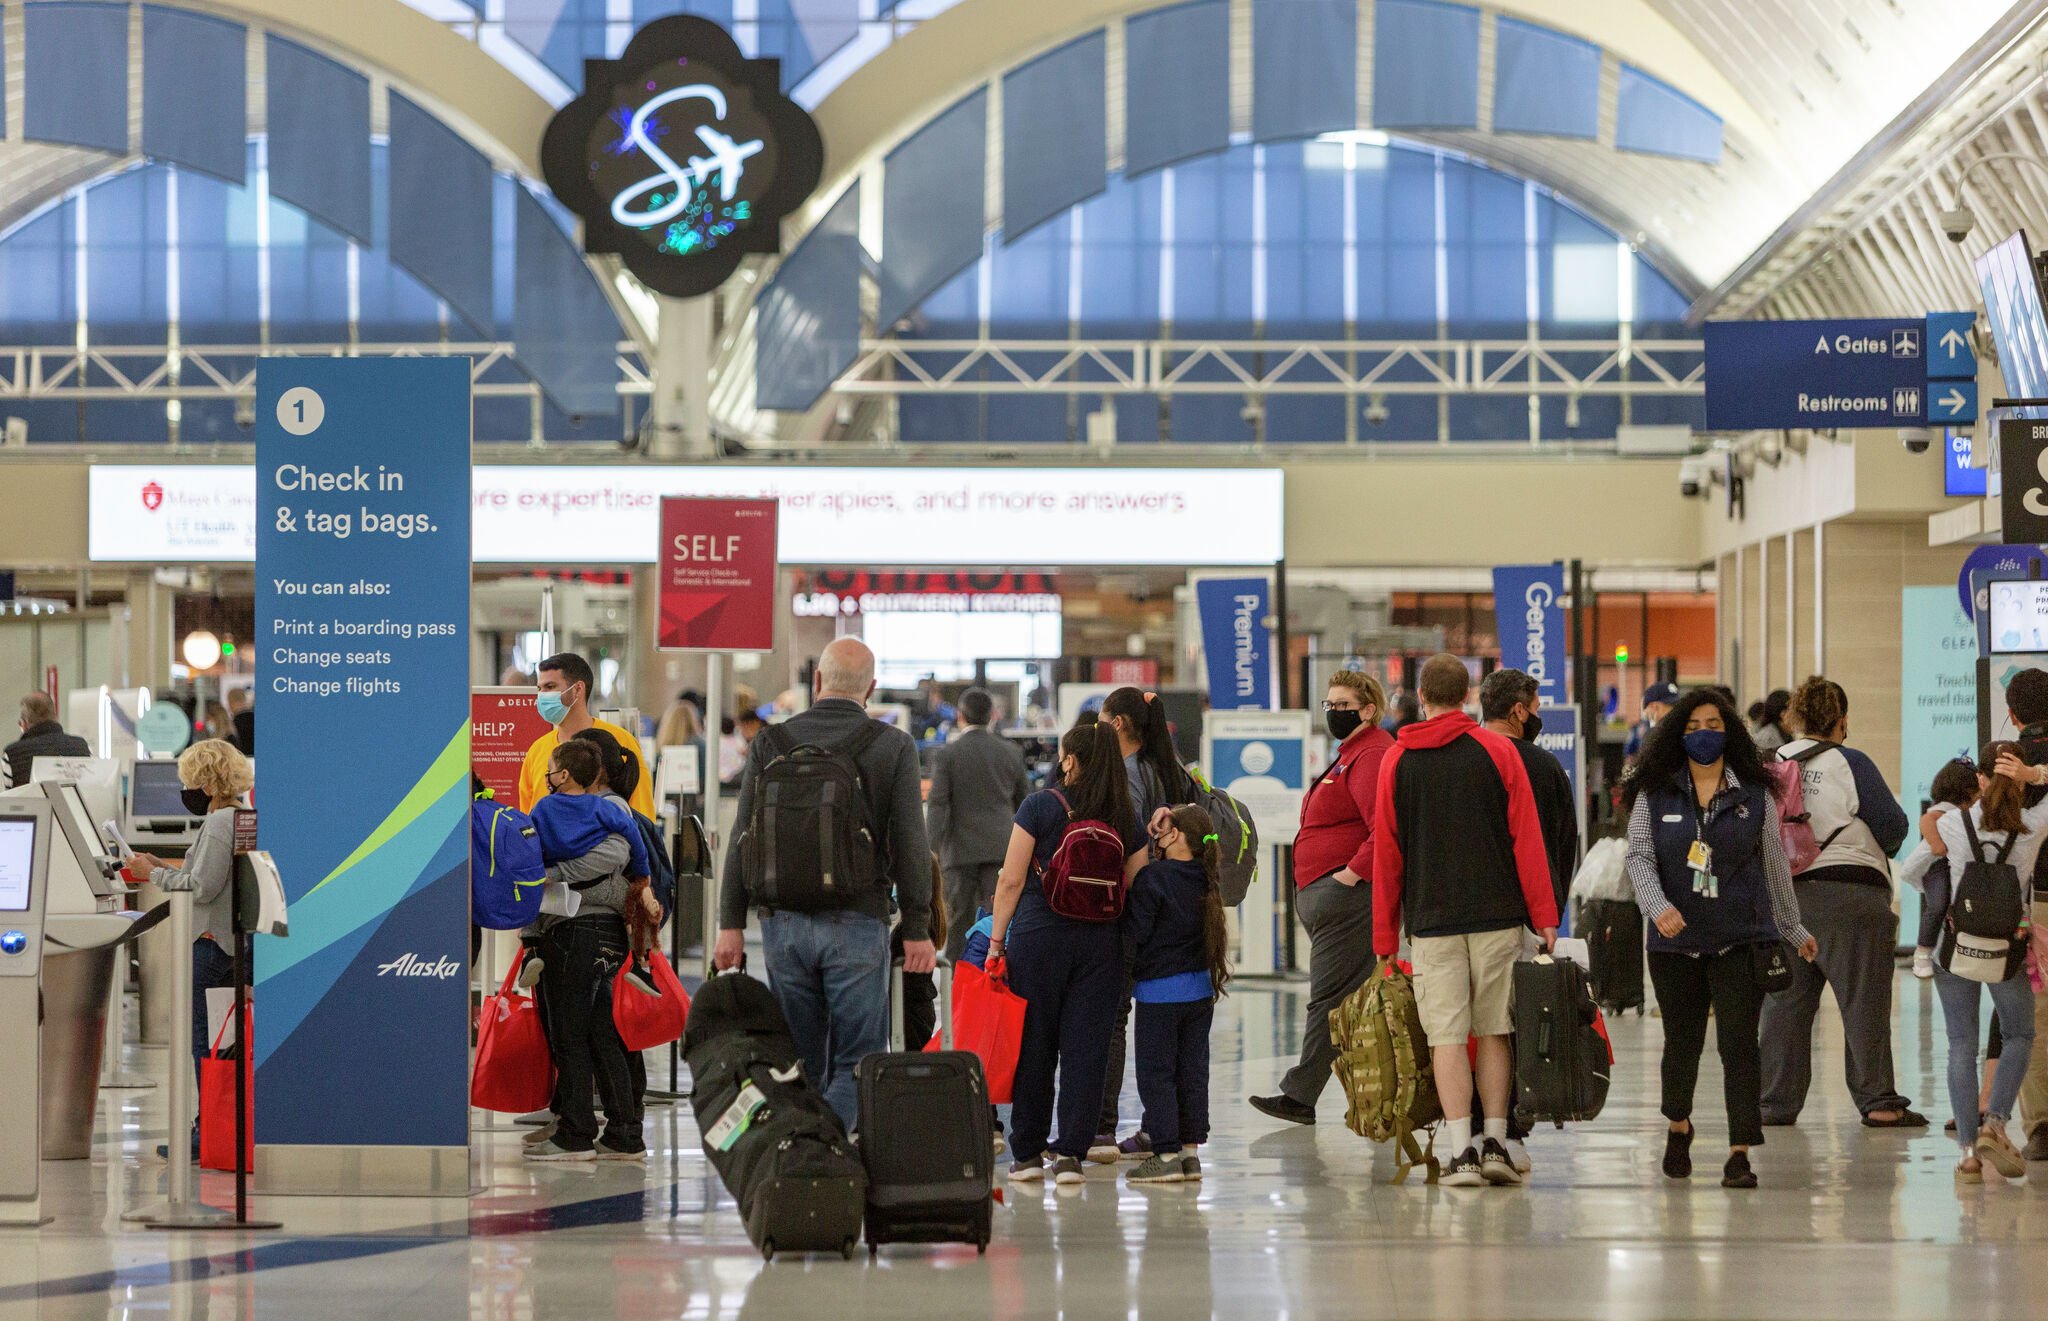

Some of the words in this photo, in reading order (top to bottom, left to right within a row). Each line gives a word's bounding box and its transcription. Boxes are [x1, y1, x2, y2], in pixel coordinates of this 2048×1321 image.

[1815, 334, 1830, 354] A
[1835, 335, 1887, 354] Gates
[292, 399, 304, 423] 1
[1798, 393, 1887, 412] Restrooms
[275, 464, 370, 491] Check
[379, 465, 403, 491] in
[915, 481, 969, 512] and
[1063, 490, 1188, 513] answers
[275, 506, 297, 532] &
[305, 509, 351, 539] tag
[361, 506, 438, 539] bags.
[673, 534, 741, 561] SELF
[274, 579, 307, 595] You
[312, 583, 343, 595] can
[349, 579, 391, 595] also:
[273, 619, 315, 635] Print
[319, 624, 329, 635] a
[334, 619, 412, 639] boarding
[417, 624, 456, 638] pass
[1525, 581, 1556, 687] General
[1233, 594, 1260, 697] Premium
[273, 648, 341, 668] Change
[345, 650, 391, 664] seats
[273, 677, 341, 697] Change
[346, 677, 400, 697] flights
[472, 722, 515, 737] HELP?
[1955, 945, 1992, 959] adden
[377, 952, 460, 980] Alaska
